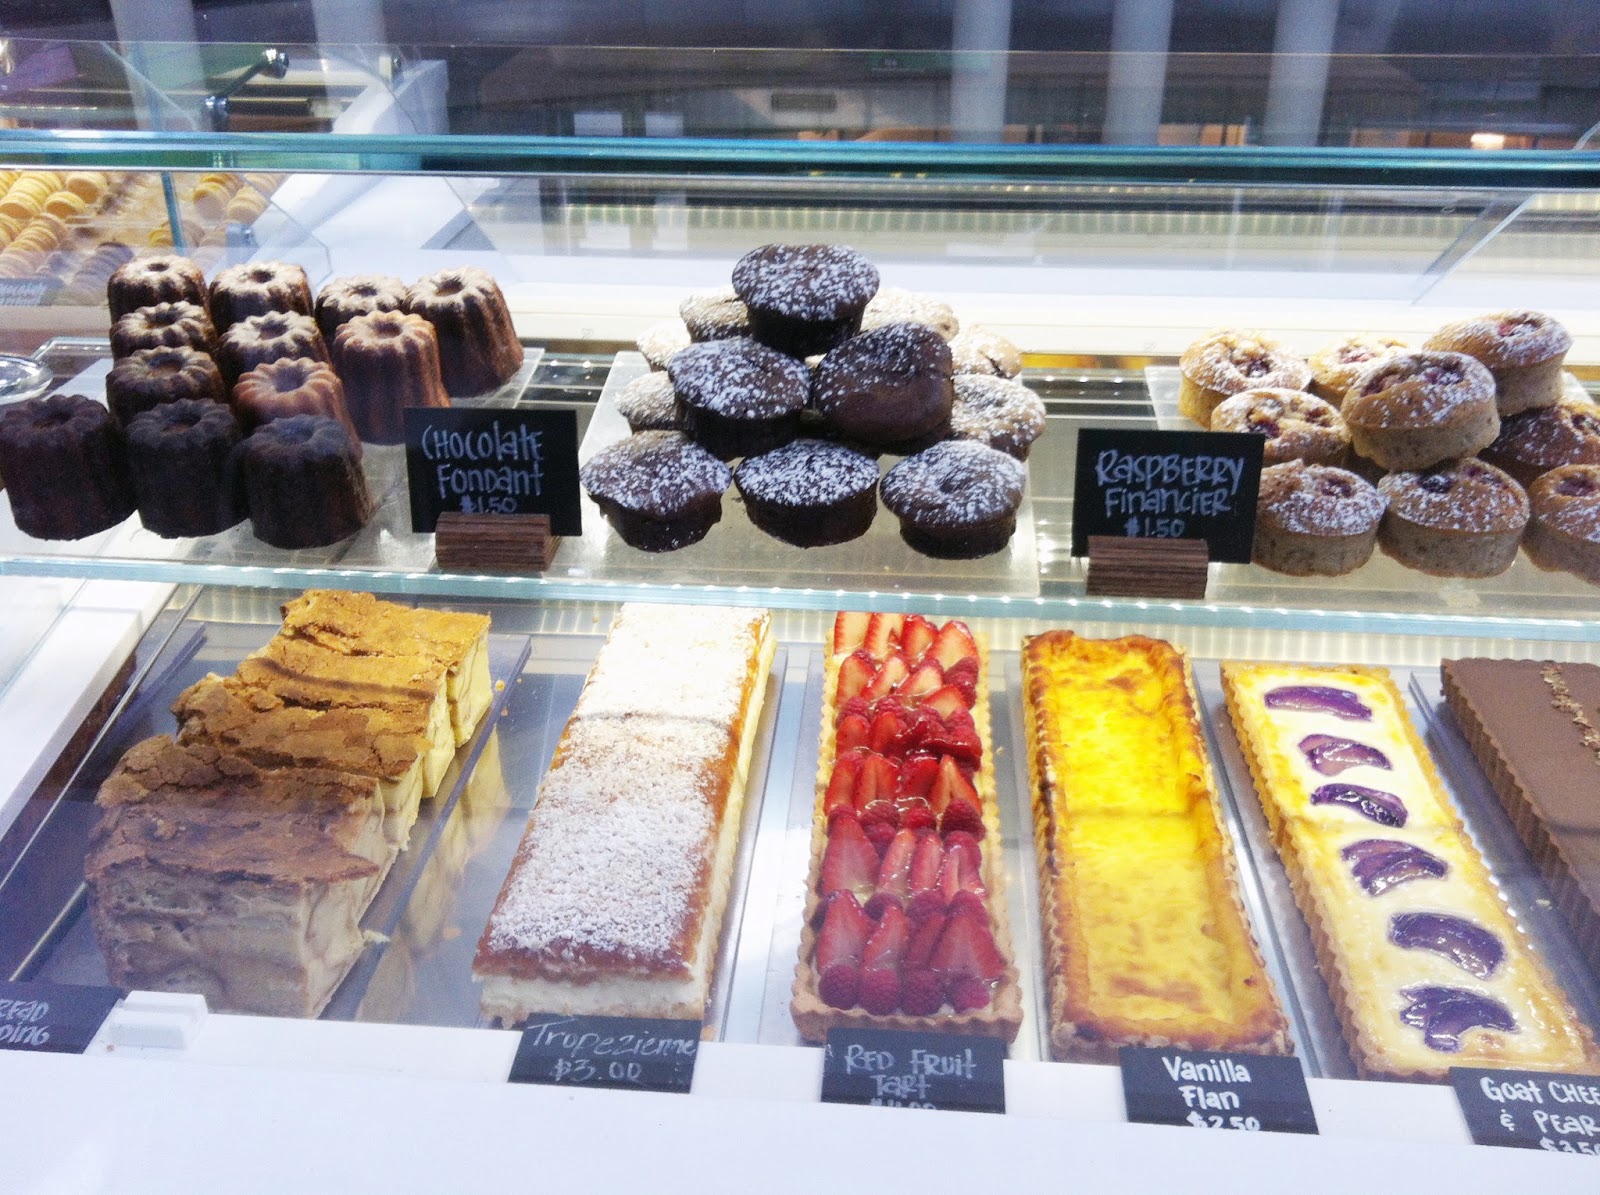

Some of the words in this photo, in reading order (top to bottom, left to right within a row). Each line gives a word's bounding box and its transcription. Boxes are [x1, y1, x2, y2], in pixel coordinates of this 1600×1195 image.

[549, 1058, 642, 1083] $3.00
[1161, 1055, 1252, 1083] Vanilla
[1177, 1085, 1240, 1110] Flan
